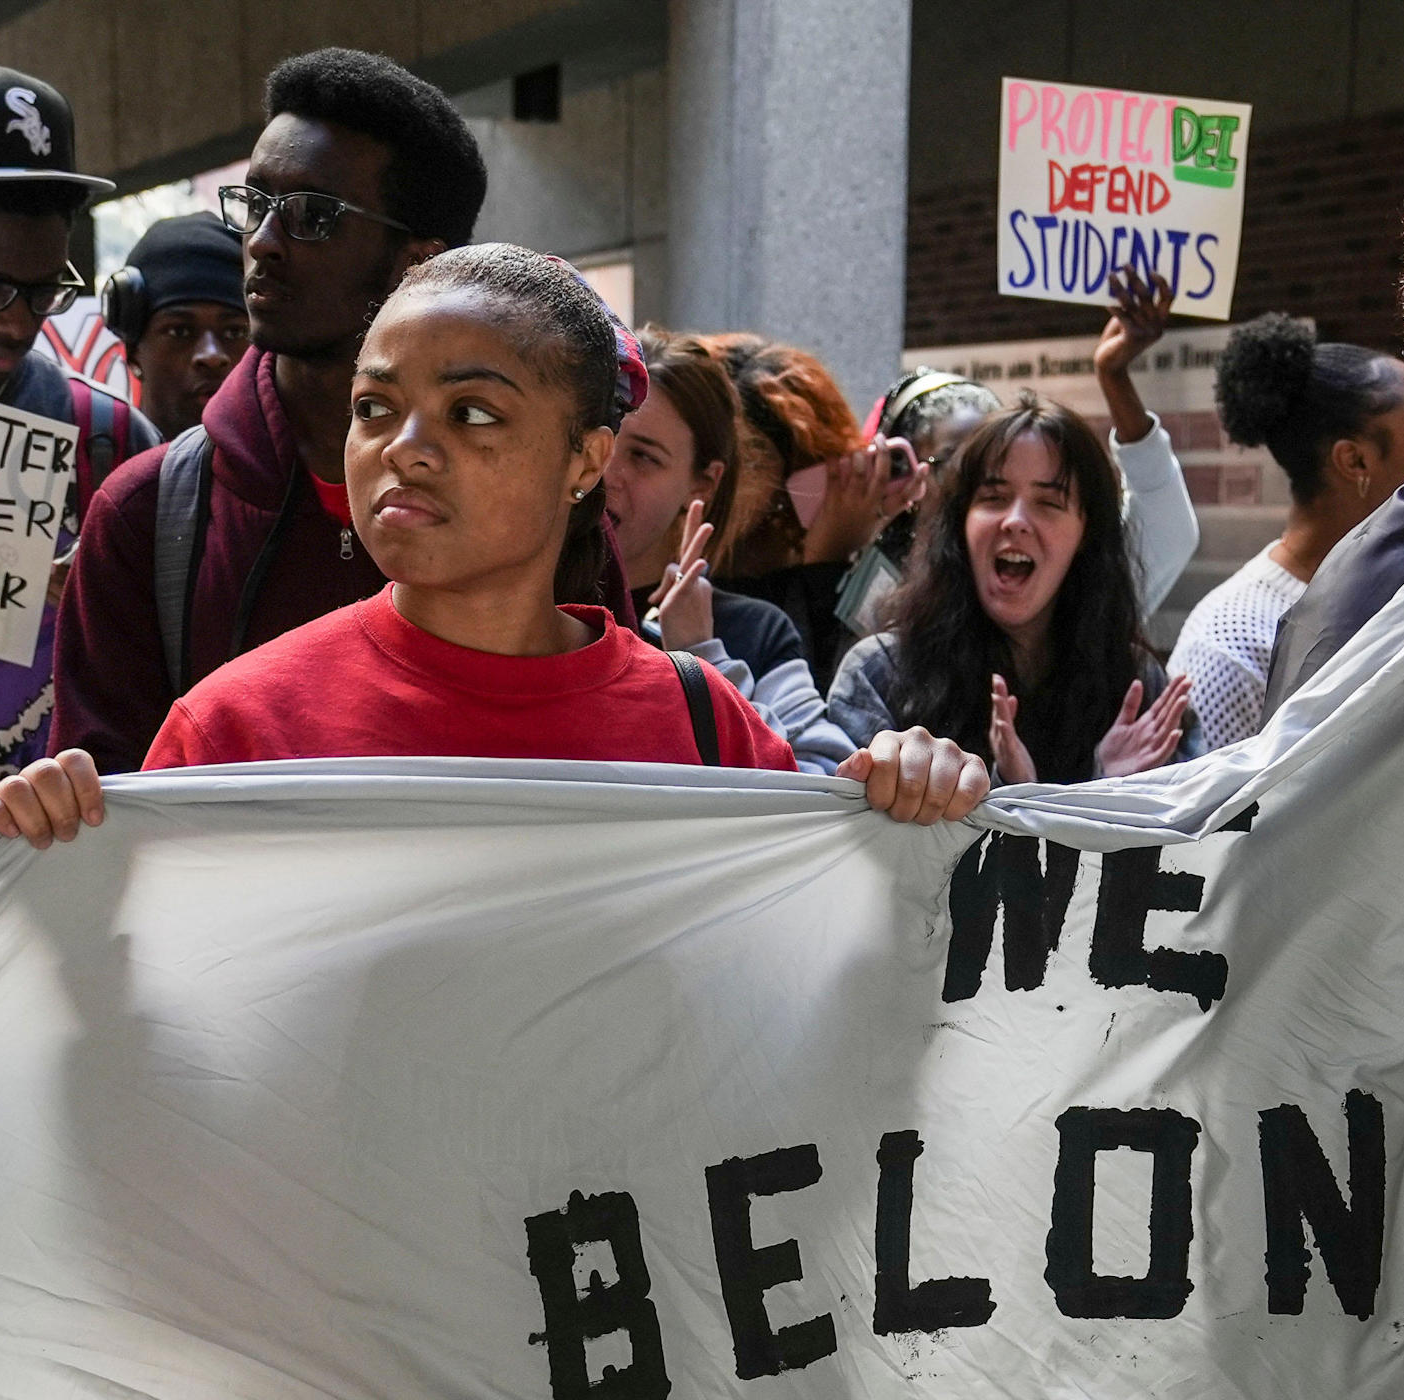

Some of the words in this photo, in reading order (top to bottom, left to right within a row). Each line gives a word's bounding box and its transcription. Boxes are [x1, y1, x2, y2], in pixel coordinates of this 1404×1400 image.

[1007, 82, 1178, 168] PROTECT
[1172, 106, 1240, 172] DEI
[1048, 160, 1171, 216] DEFEND
[1008, 209, 1219, 300] STUDENTS
[942, 803, 1259, 1012] WE
